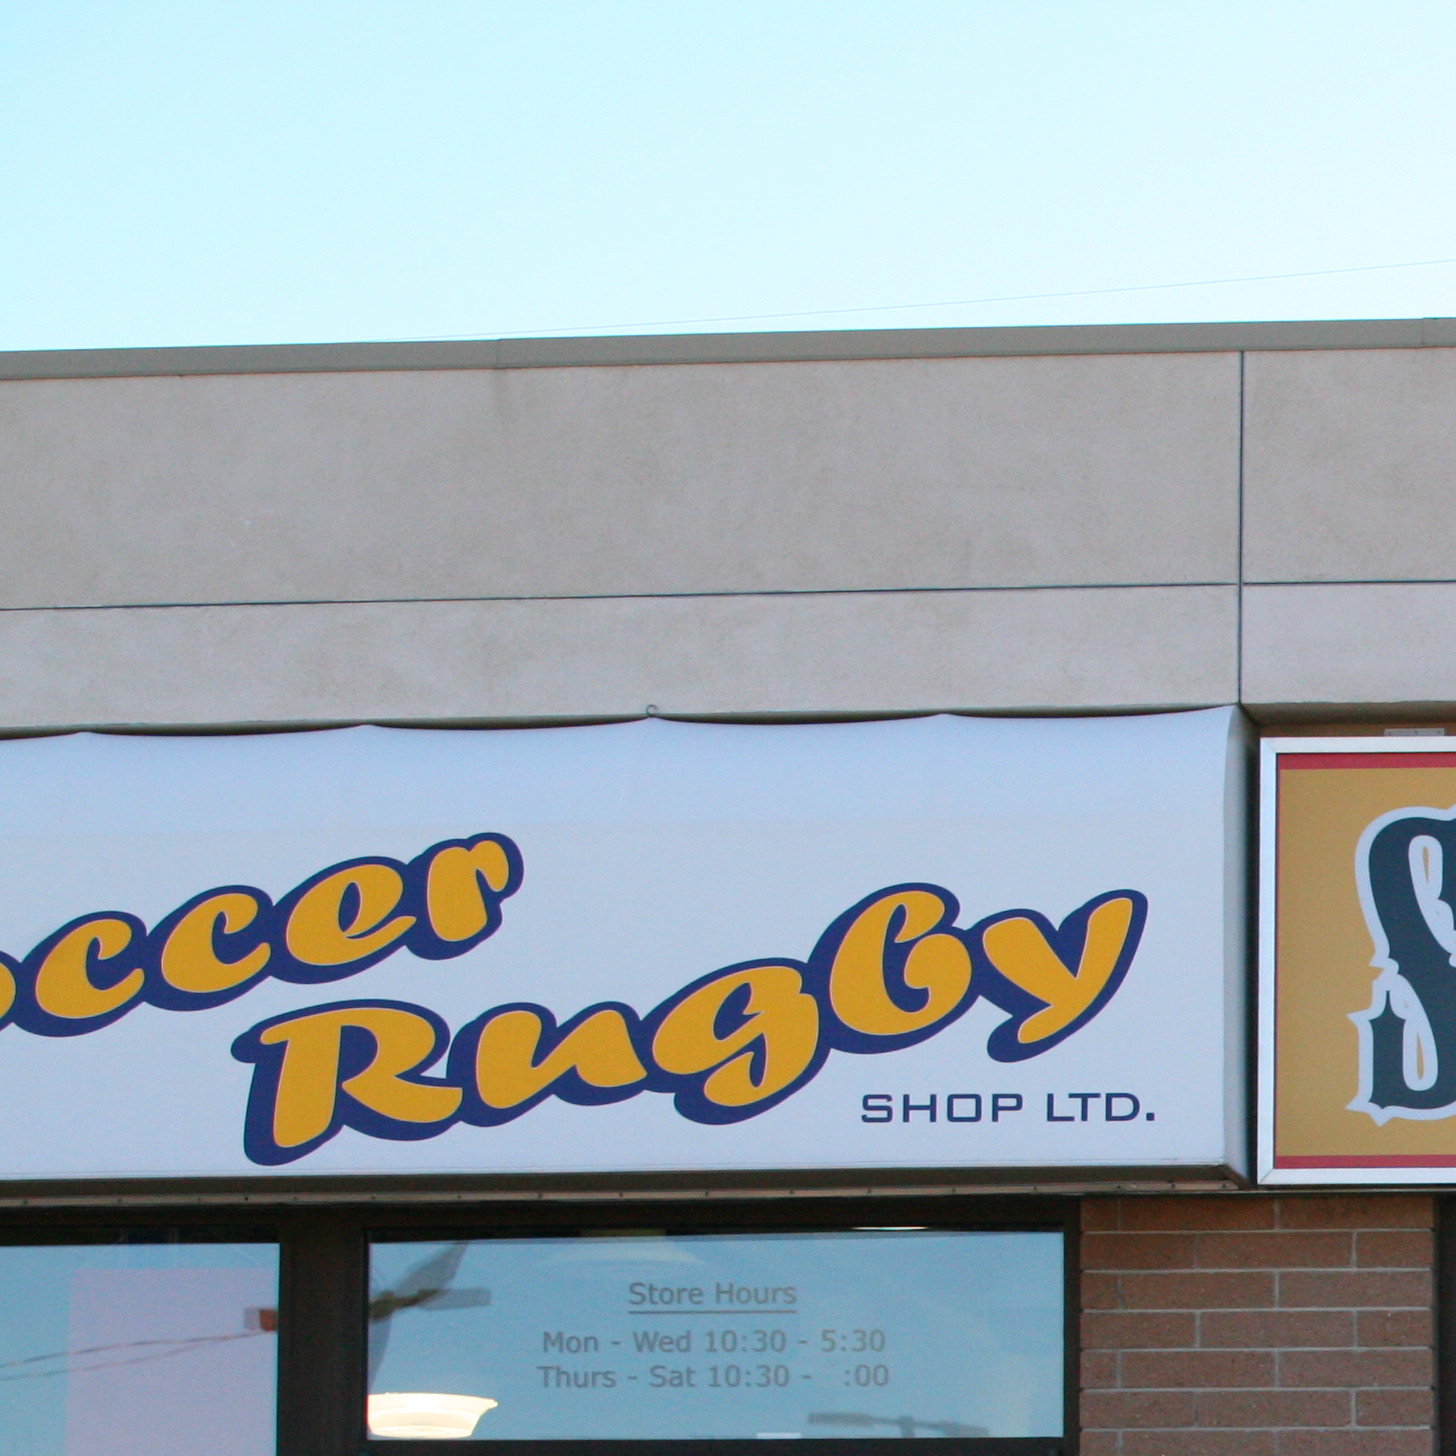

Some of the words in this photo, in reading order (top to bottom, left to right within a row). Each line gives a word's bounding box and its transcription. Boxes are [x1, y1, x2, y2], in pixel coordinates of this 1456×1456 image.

[0, 832, 524, 1037] ccer
[861, 1093, 1023, 1123] SHOP
[1046, 1092, 1155, 1122] LTD.
[628, 1282, 703, 1305] Store
[715, 1282, 797, 1305] Hours
[542, 1331, 599, 1353] Mon
[633, 1330, 692, 1353] Wed
[705, 1330, 786, 1353] 10:30
[820, 1329, 886, 1352] 5:30
[536, 1365, 617, 1388] Thurs
[649, 1365, 696, 1388] Sat
[707, 1365, 790, 1388] 10:30
